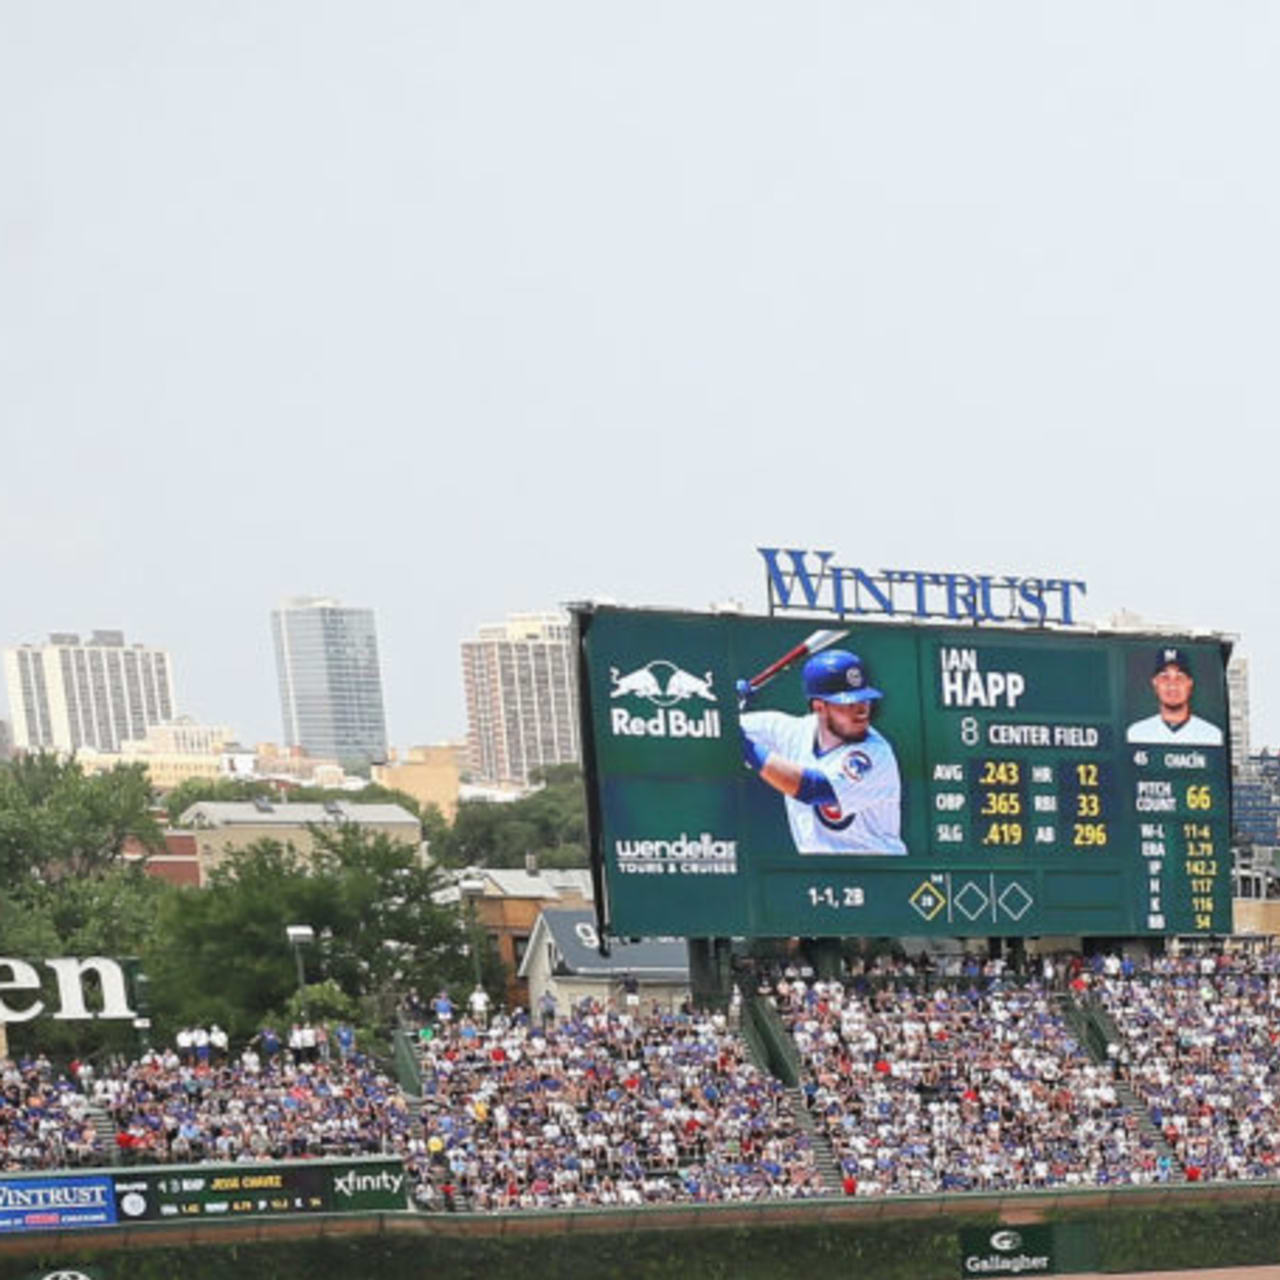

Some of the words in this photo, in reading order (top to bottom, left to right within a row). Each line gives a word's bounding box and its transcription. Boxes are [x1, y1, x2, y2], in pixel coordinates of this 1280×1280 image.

[757, 548, 1087, 625] WINTRUST
[941, 648, 976, 670] IAN
[942, 671, 1024, 707] HAPP
[611, 708, 665, 736] Red
[669, 710, 721, 738] Bull
[961, 716, 980, 746] 8
[989, 725, 1050, 746] CENTER
[1054, 727, 1099, 747] FIELD
[933, 764, 963, 780] AVG
[979, 761, 1020, 784] .243
[1032, 766, 1053, 783] HR
[1076, 764, 1099, 786] 12
[936, 793, 966, 811] OBP
[981, 792, 1020, 814] .365
[1077, 795, 1099, 816] 33
[1186, 785, 1211, 809] 66
[982, 823, 1022, 845] .419
[1035, 827, 1055, 843] AB
[1074, 824, 1107, 845] 296
[618, 863, 664, 874] TOURS
[681, 863, 738, 875] CRUISES
[334, 1171, 402, 1195] xfinity
[966, 1255, 1049, 1272] Gallagher
